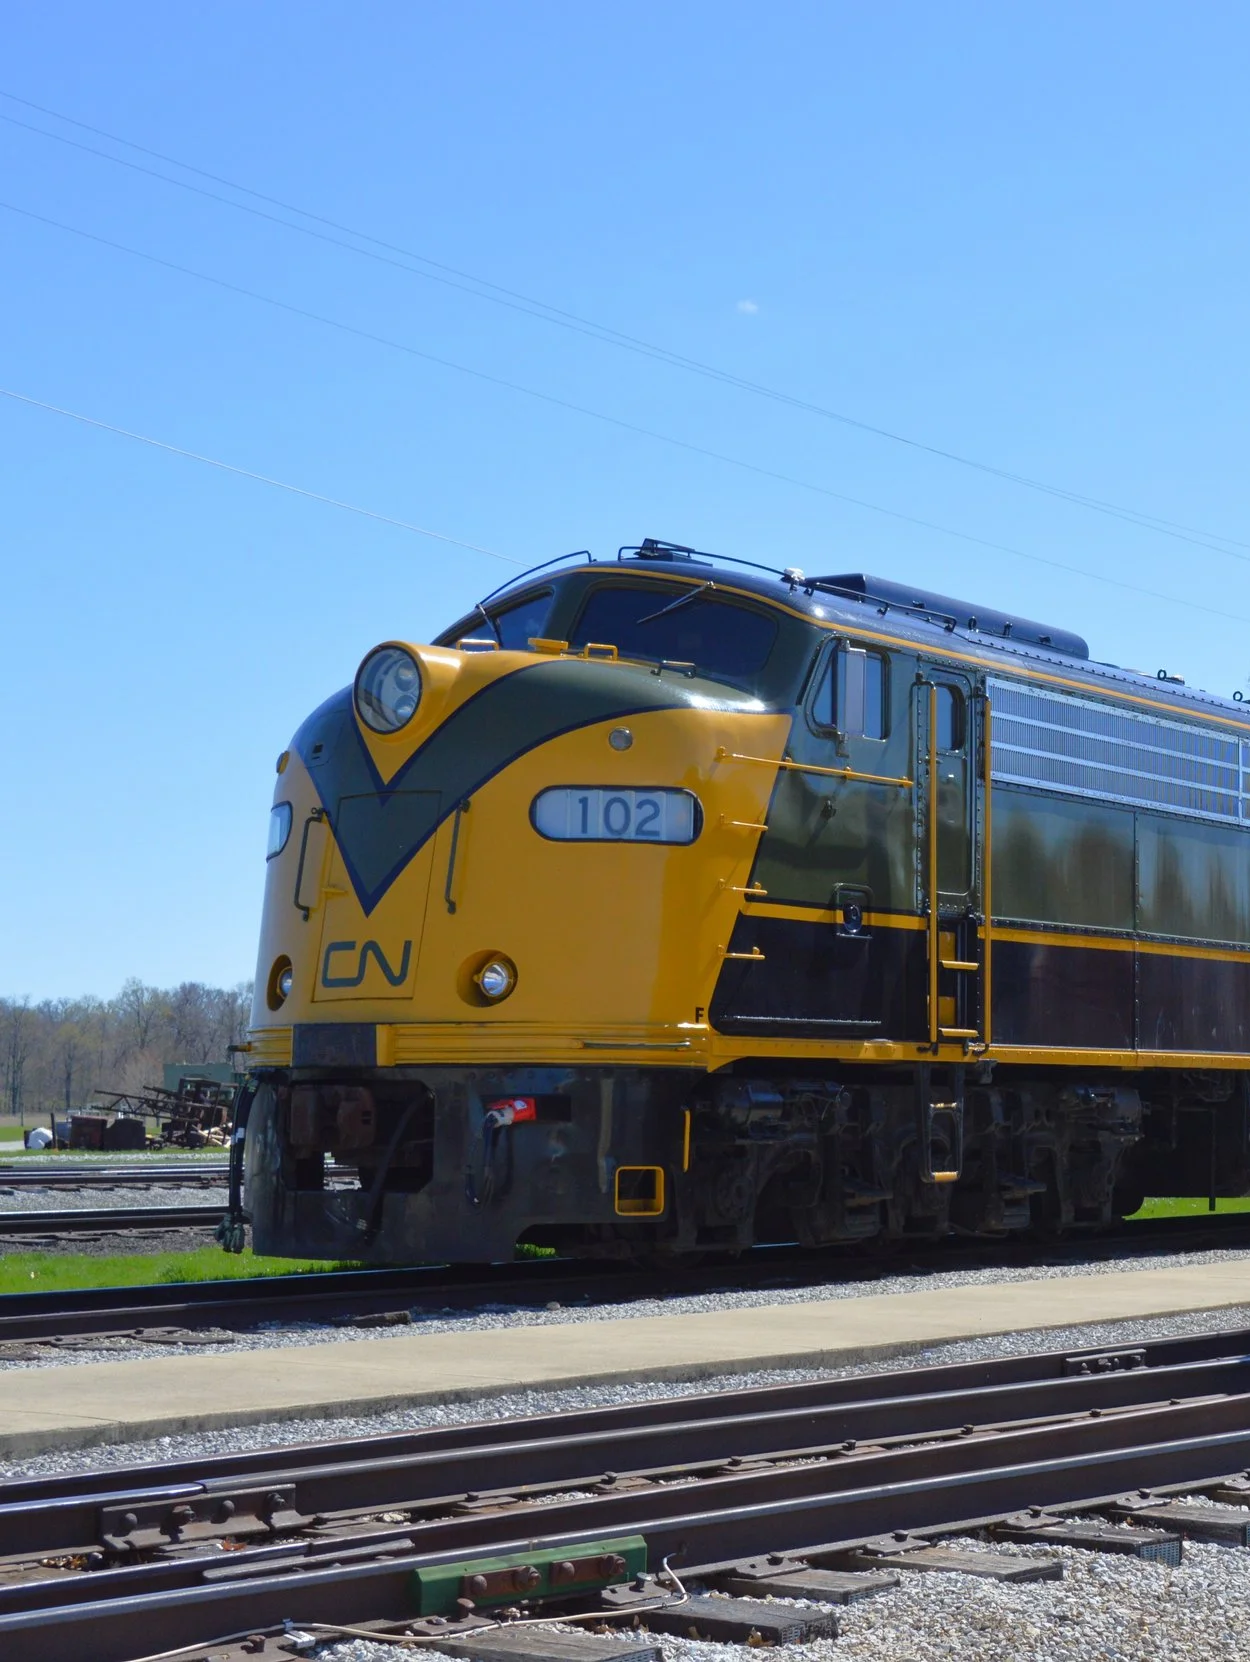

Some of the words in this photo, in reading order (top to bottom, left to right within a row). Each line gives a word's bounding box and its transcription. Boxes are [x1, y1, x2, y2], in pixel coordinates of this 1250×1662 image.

[577, 796, 660, 837] 102
[322, 940, 412, 988] CN
[695, 1007, 705, 1024] F
